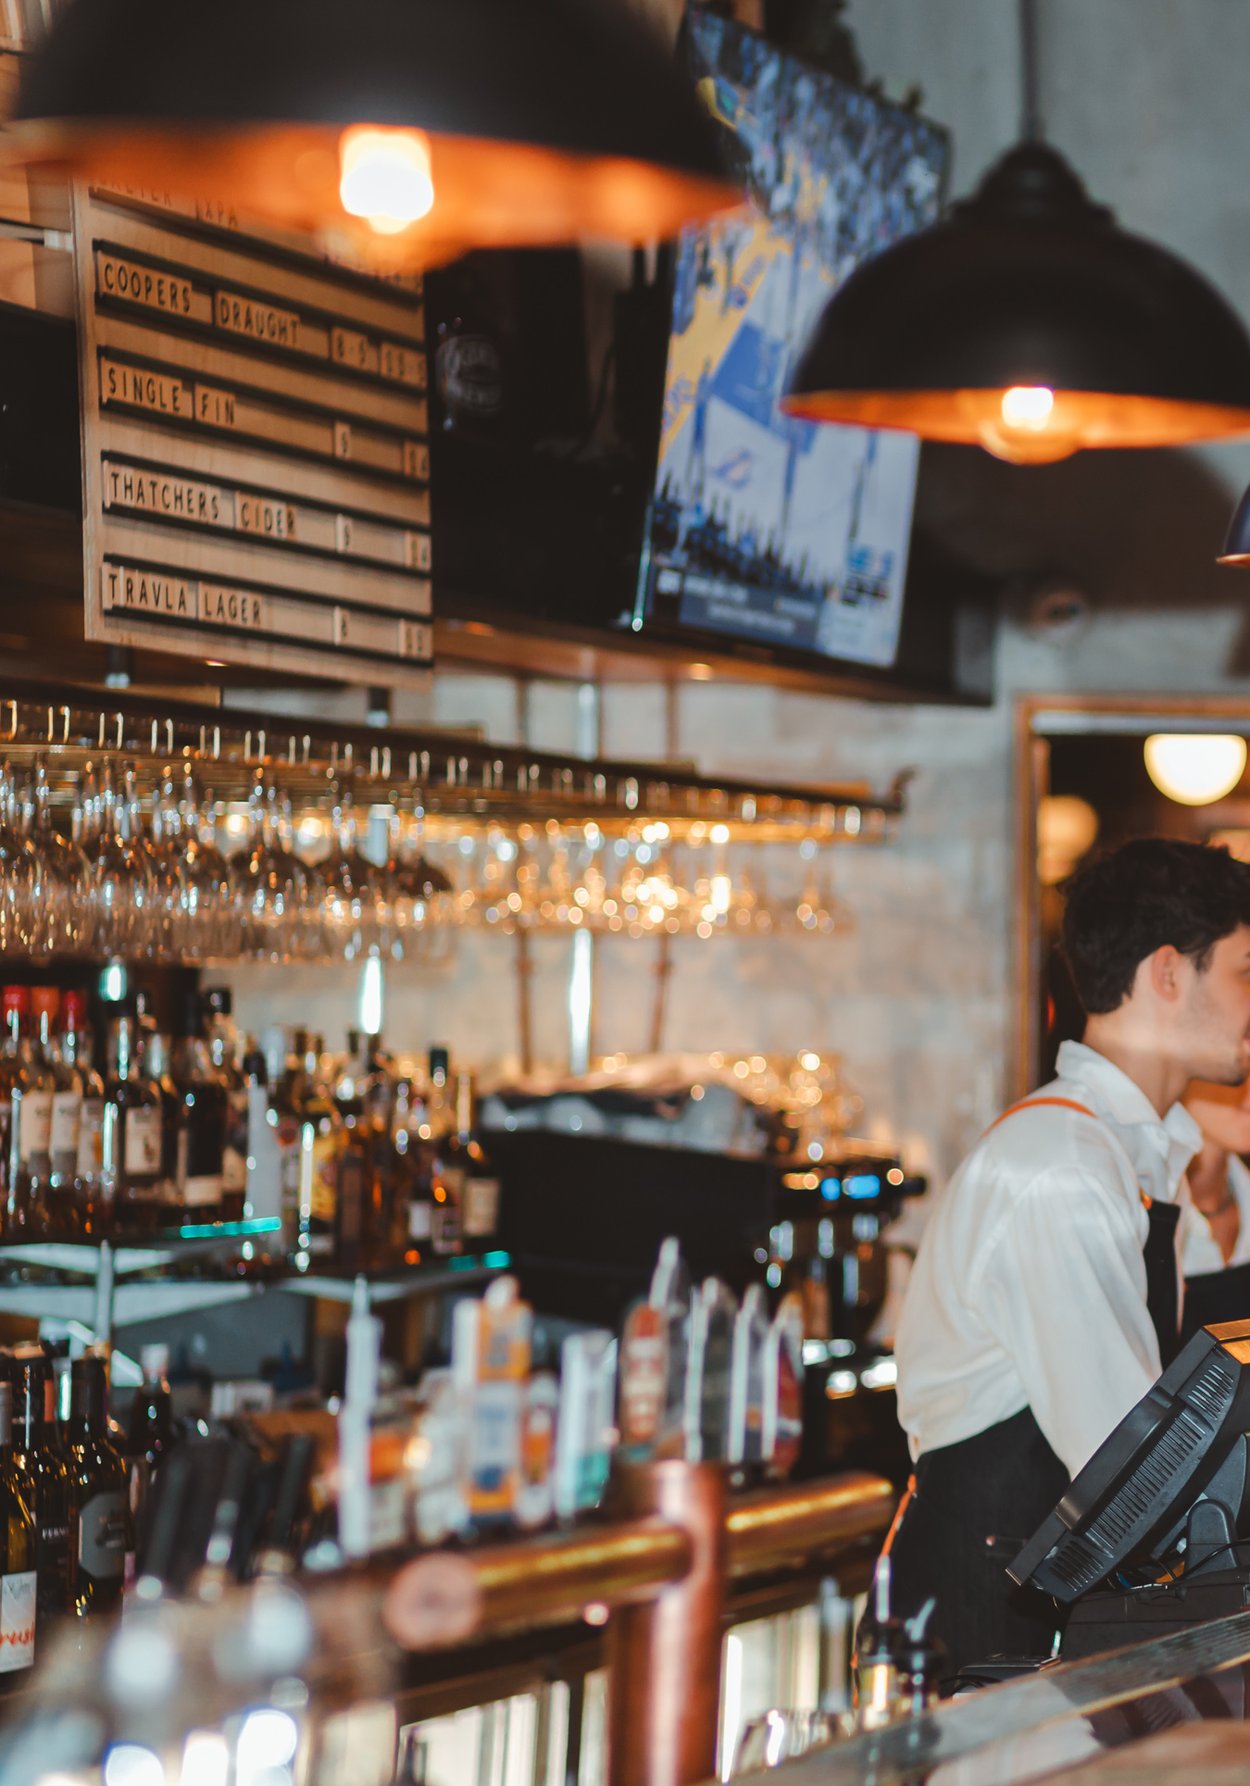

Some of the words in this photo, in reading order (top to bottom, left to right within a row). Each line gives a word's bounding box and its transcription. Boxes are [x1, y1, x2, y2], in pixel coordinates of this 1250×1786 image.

[104, 263, 191, 313] COOPERS
[220, 294, 299, 346] DRAUGHT
[109, 371, 181, 413] SINGLE
[202, 392, 235, 425] FIN
[111, 472, 220, 519] THATCHERS
[241, 504, 296, 535] CIDER
[109, 573, 187, 612] TRAVLA
[205, 590, 261, 625] LAGER
